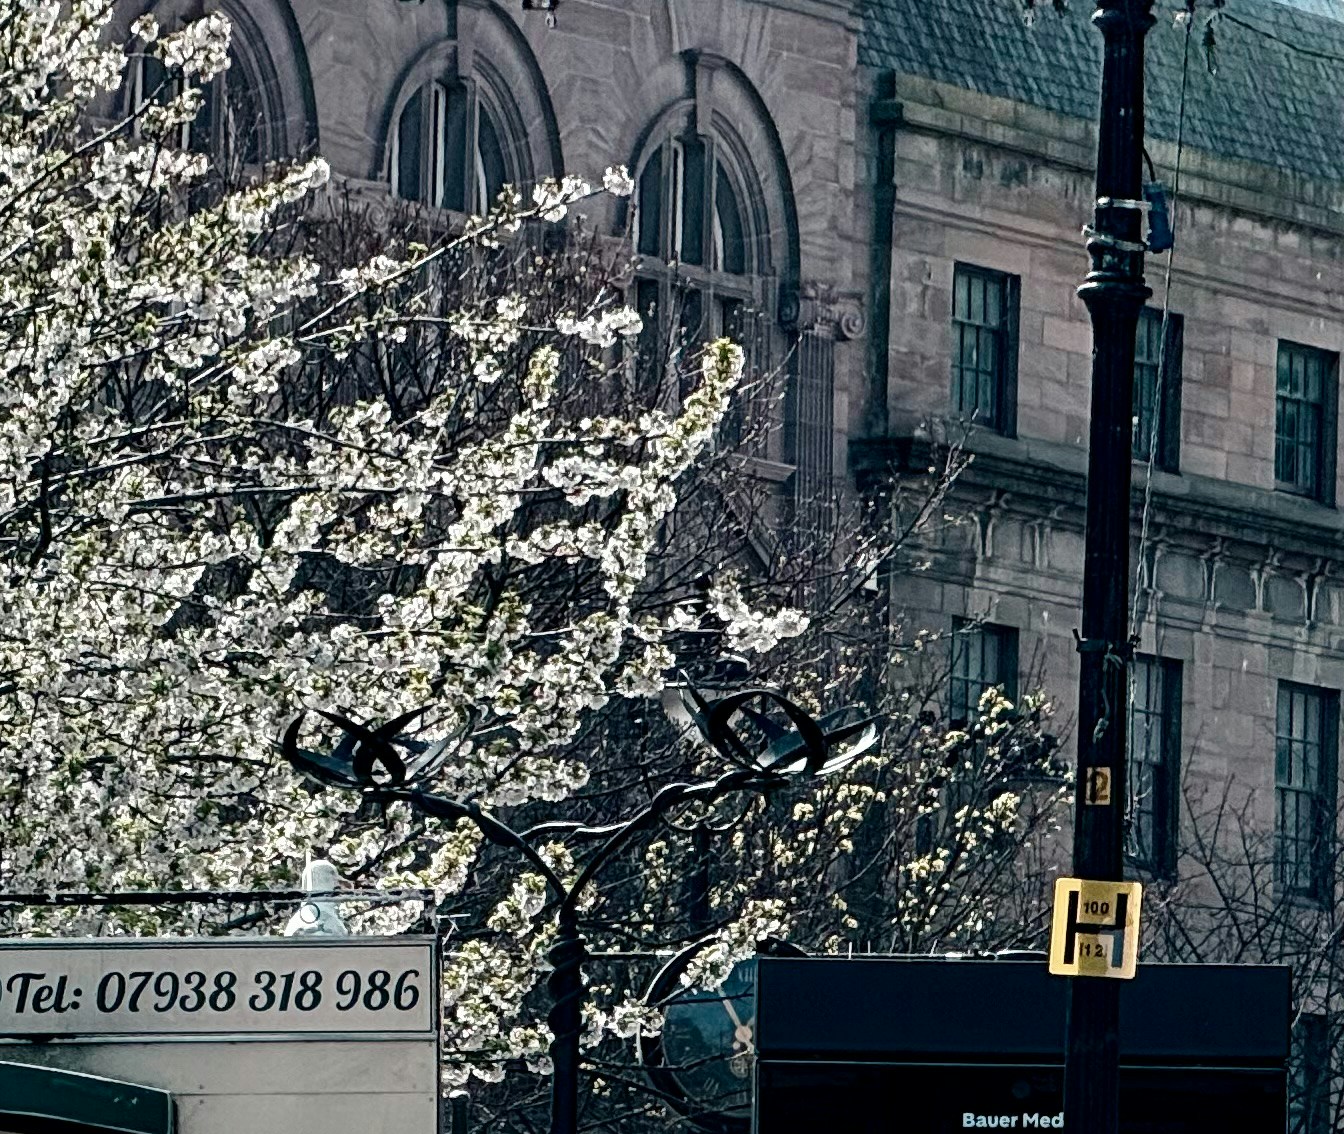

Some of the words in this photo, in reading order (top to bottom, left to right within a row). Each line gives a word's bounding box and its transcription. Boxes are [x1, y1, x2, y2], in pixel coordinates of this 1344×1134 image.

[1083, 901, 1110, 915] 100
[6, 971, 83, 1014] Tel:
[96, 970, 238, 1014] 07938
[248, 970, 322, 1012] 318
[335, 969, 421, 1012] 986
[962, 1112, 1018, 1128] Bauer
[1022, 1112, 1064, 1128] Med
